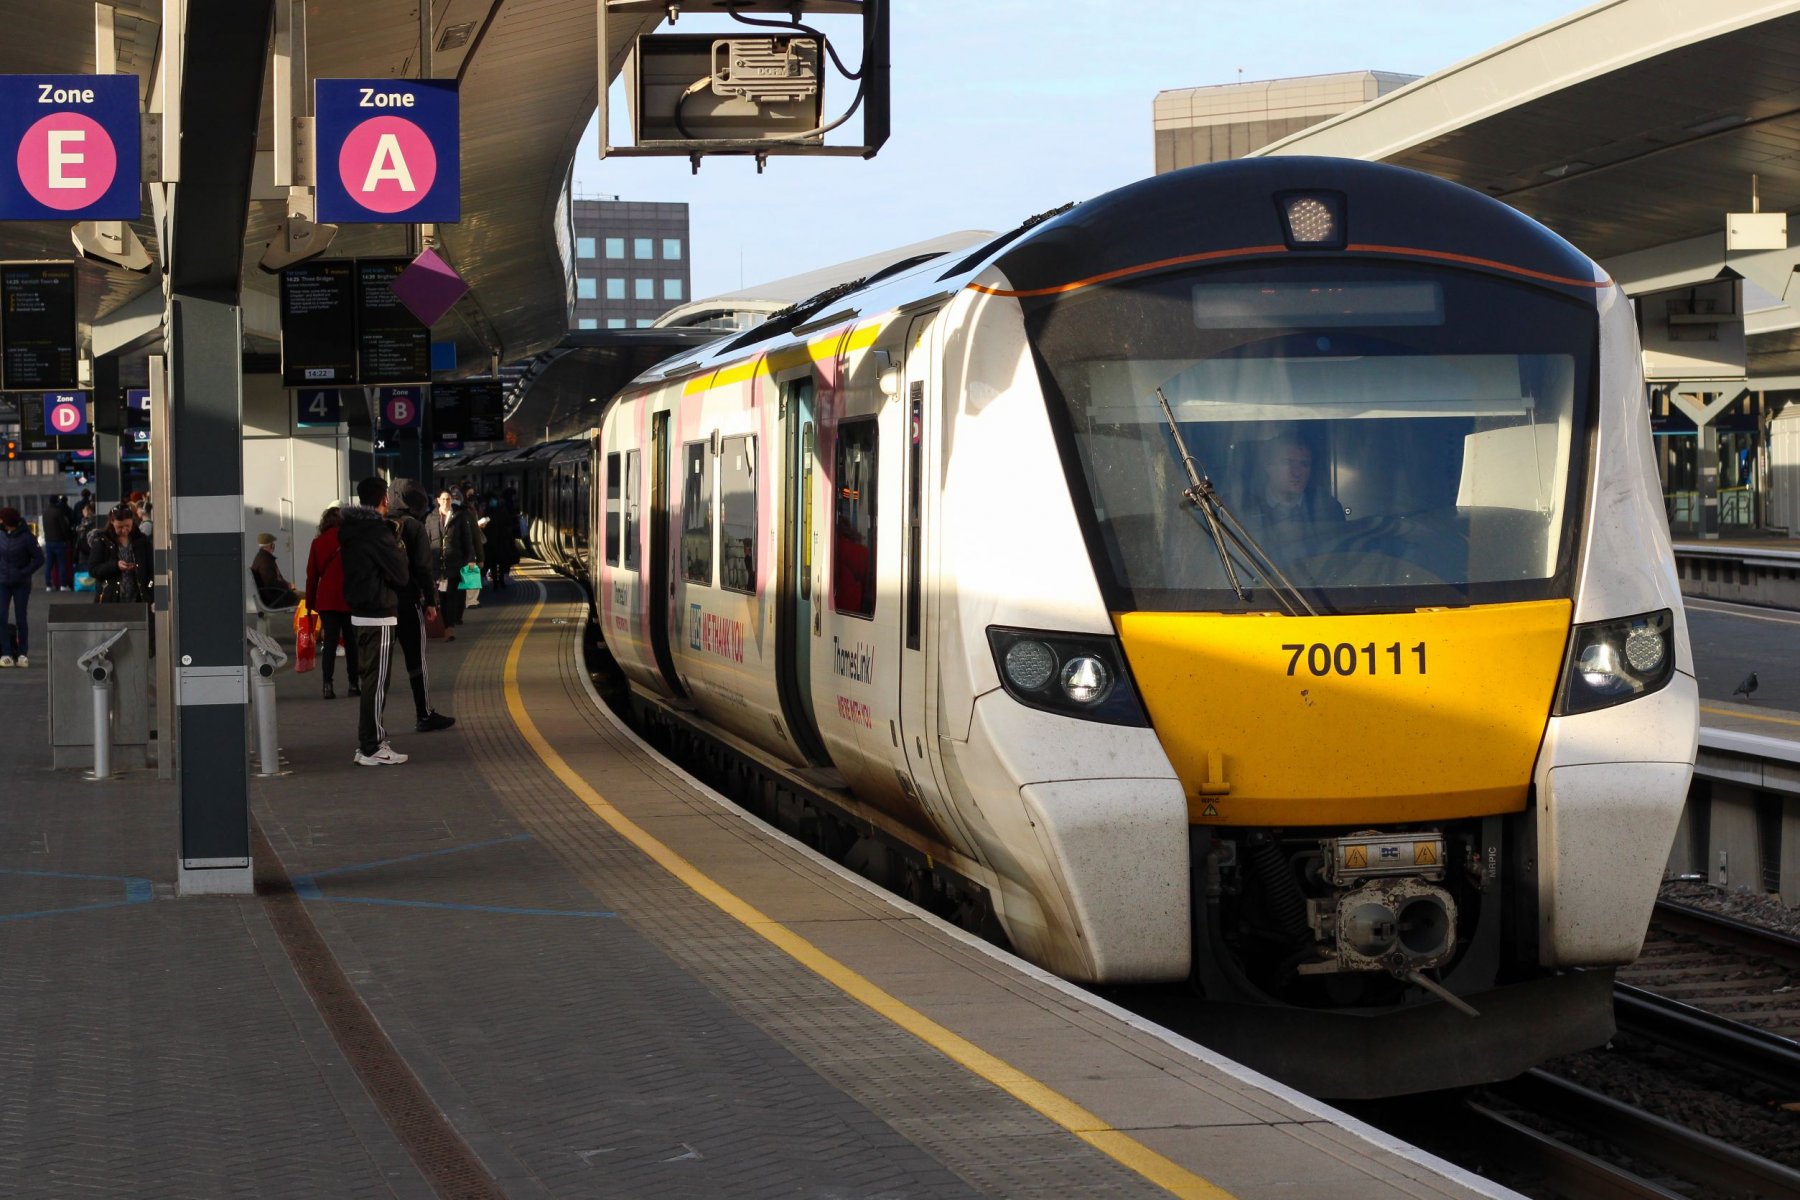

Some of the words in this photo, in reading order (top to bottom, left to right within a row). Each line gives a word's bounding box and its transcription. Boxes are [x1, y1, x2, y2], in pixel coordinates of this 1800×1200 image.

[38, 85, 95, 104] Zone
[359, 88, 415, 108] Zone
[47, 130, 87, 189] E
[362, 133, 416, 192] A
[56, 395, 74, 403] Zone
[308, 391, 328, 417] 4
[59, 408, 75, 427] D
[394, 401, 408, 420] B
[1281, 641, 1428, 677] 700111
